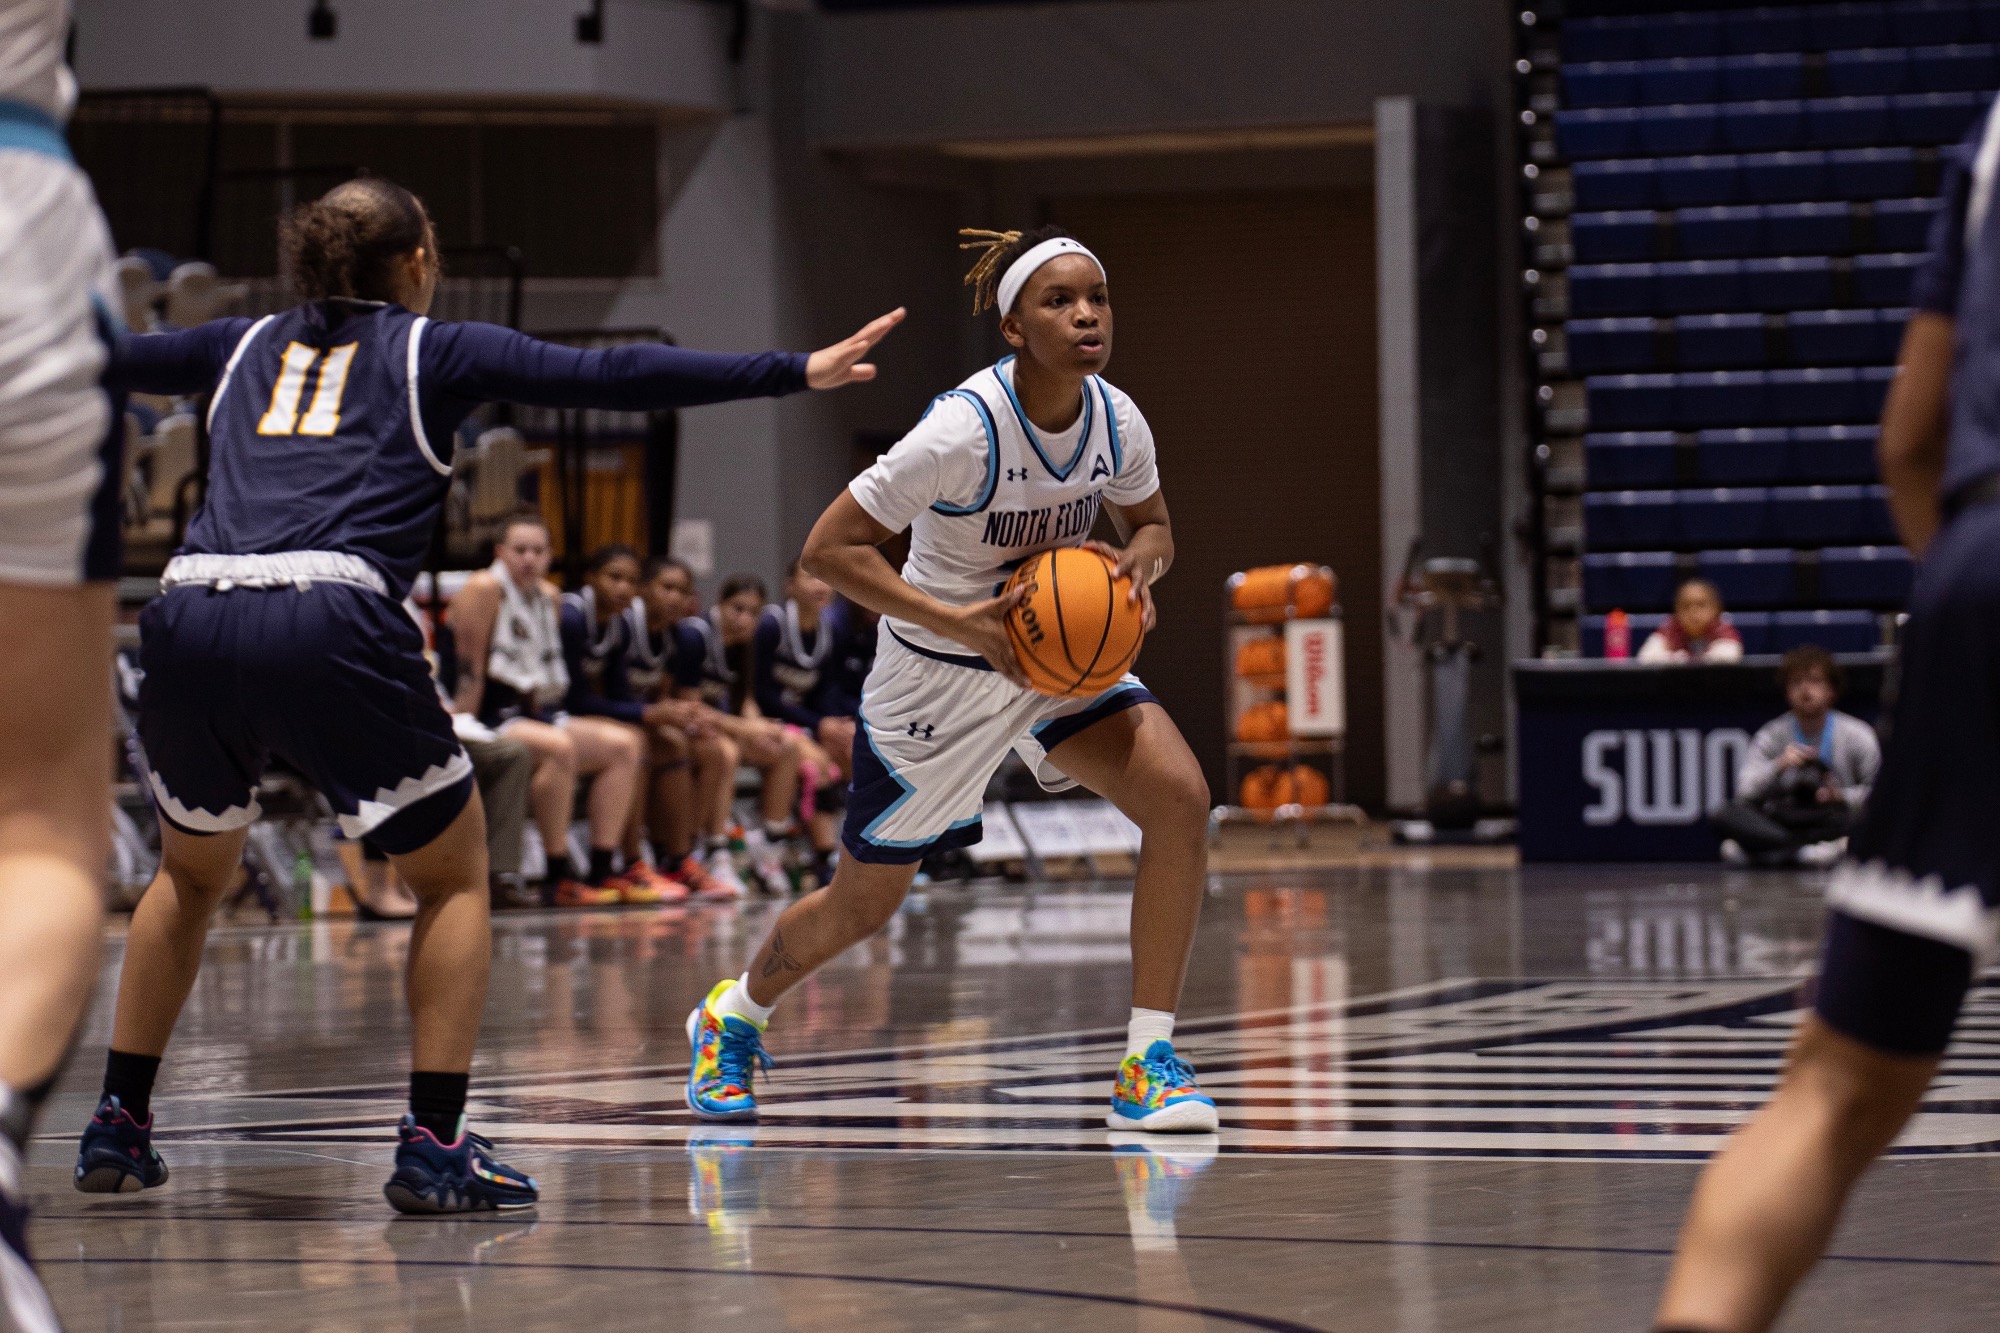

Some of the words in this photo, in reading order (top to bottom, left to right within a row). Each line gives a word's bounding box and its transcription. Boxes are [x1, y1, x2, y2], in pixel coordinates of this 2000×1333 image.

[257, 341, 359, 435] 11
[981, 507, 1052, 547] NORTH
[1053, 488, 1103, 540] FLORI
